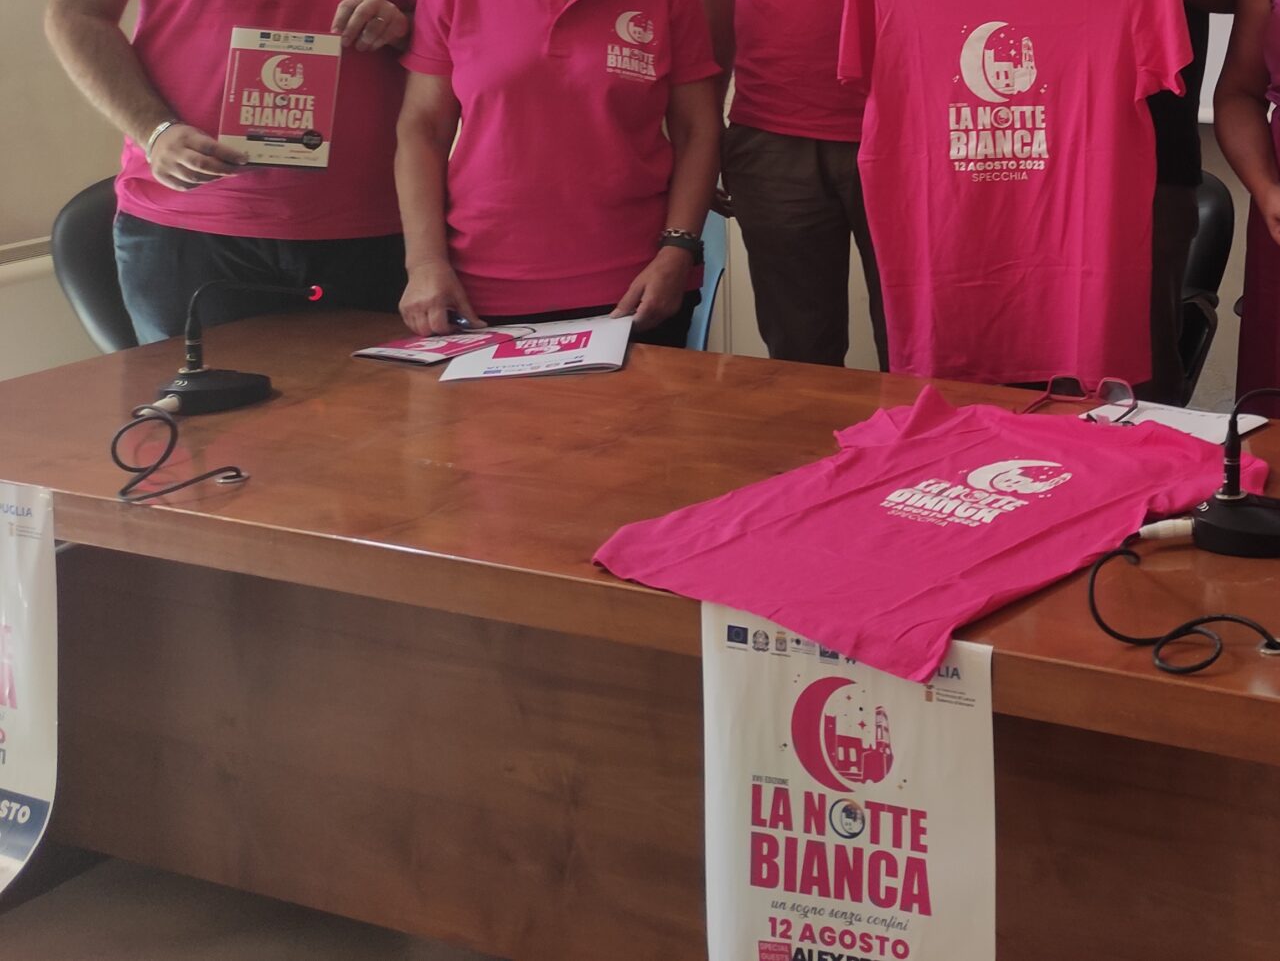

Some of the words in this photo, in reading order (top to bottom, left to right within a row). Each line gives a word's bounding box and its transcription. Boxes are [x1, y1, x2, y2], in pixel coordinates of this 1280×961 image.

[242, 89, 260, 107] LA
[239, 106, 315, 129] BIANCA
[949, 106, 974, 130] LA
[949, 129, 1049, 159] BIANCA
[954, 161, 966, 171] 12
[967, 160, 1018, 172] AGOSTO
[972, 171, 1029, 182] SPECCHIA
[751, 783, 794, 832] LA
[750, 830, 932, 917] BIANCA
[771, 899, 787, 911] un
[789, 901, 826, 919] sogno
[828, 908, 863, 926] senza
[865, 913, 910, 933] confini
[768, 916, 793, 940] 12
[799, 922, 911, 961] AGOSTO
